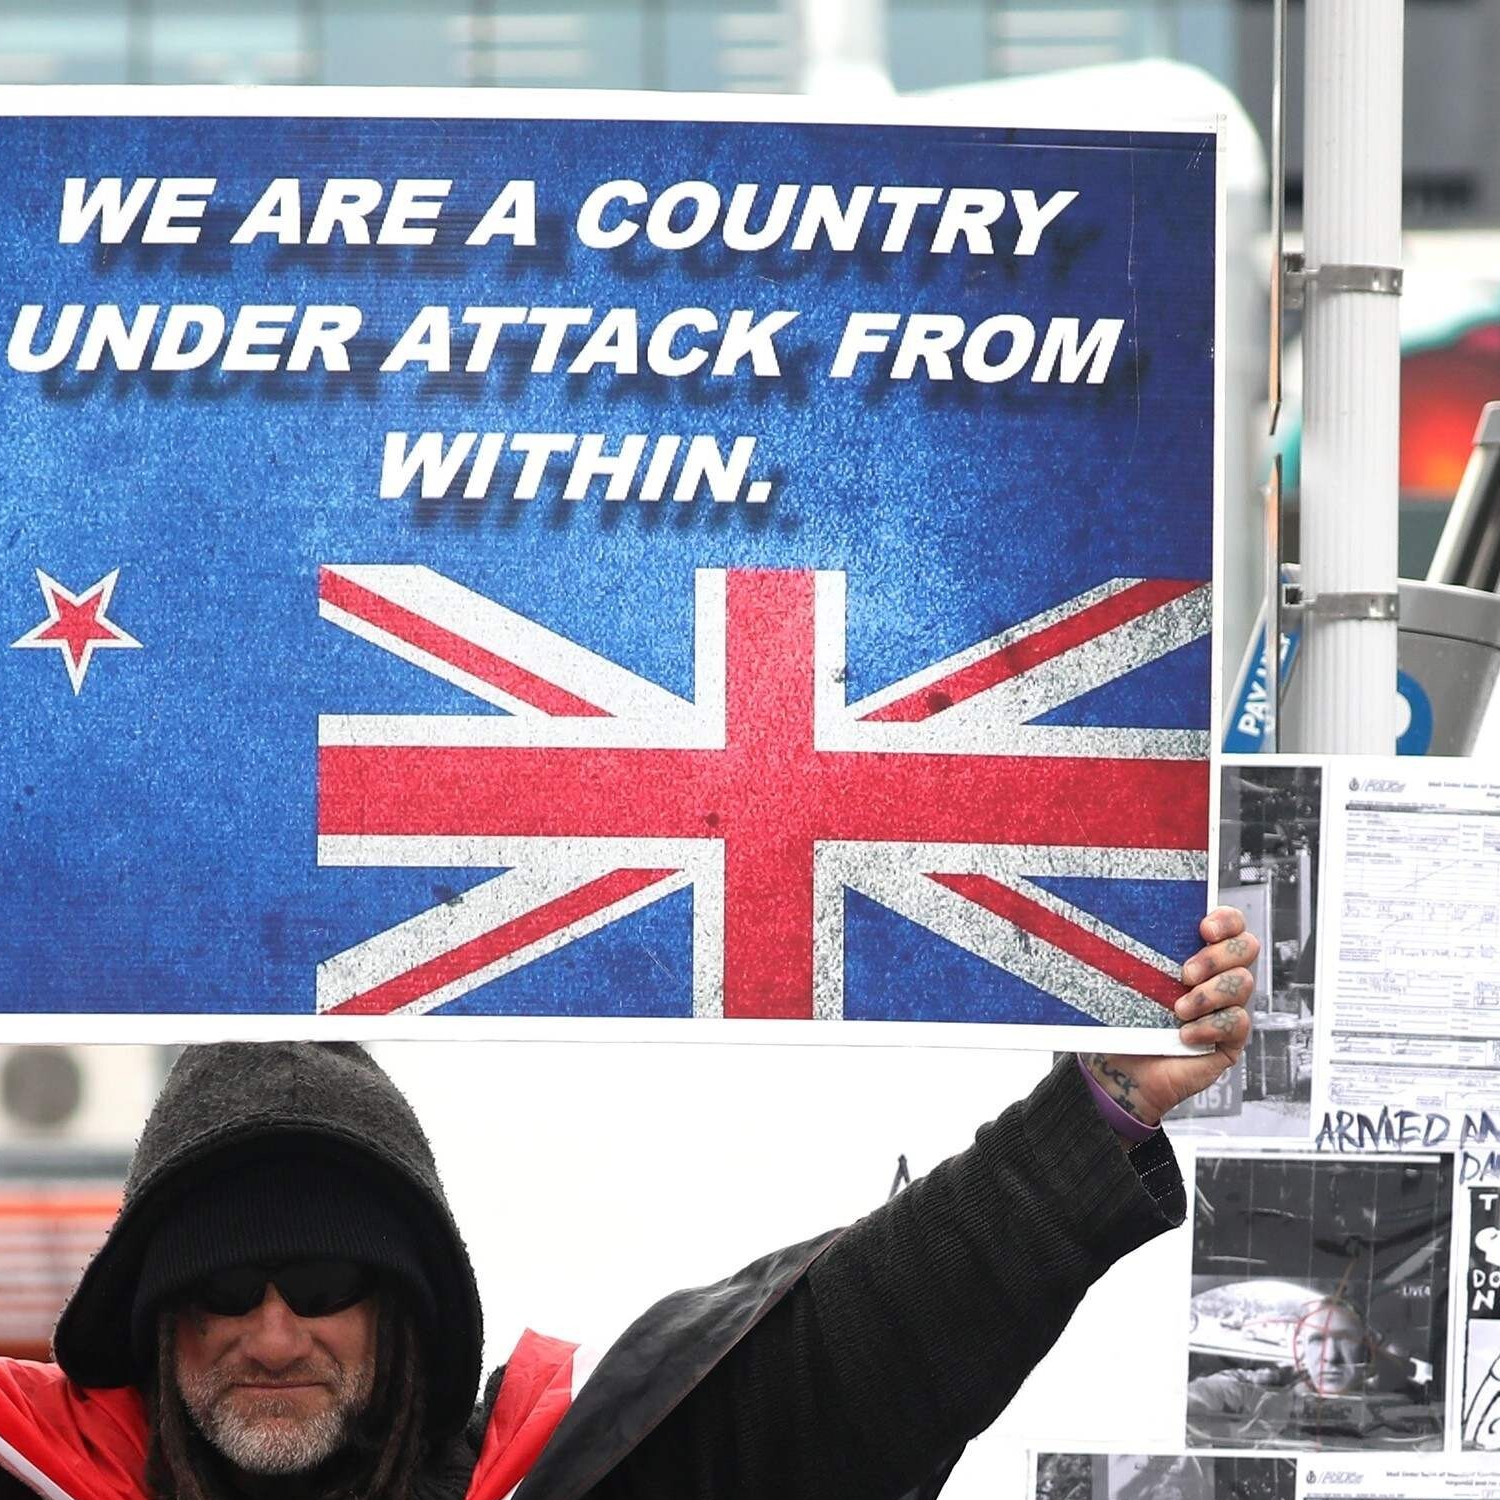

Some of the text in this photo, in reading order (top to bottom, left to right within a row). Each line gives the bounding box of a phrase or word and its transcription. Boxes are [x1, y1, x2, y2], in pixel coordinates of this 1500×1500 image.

[56, 178, 1079, 256] WE ARE A COUNTRY
[6, 303, 1124, 384] UNDER ATTACK FROM
[377, 433, 773, 504] WITHIN.
[1237, 680, 1268, 737] PAY
[1316, 1105, 1451, 1151] ARMED
